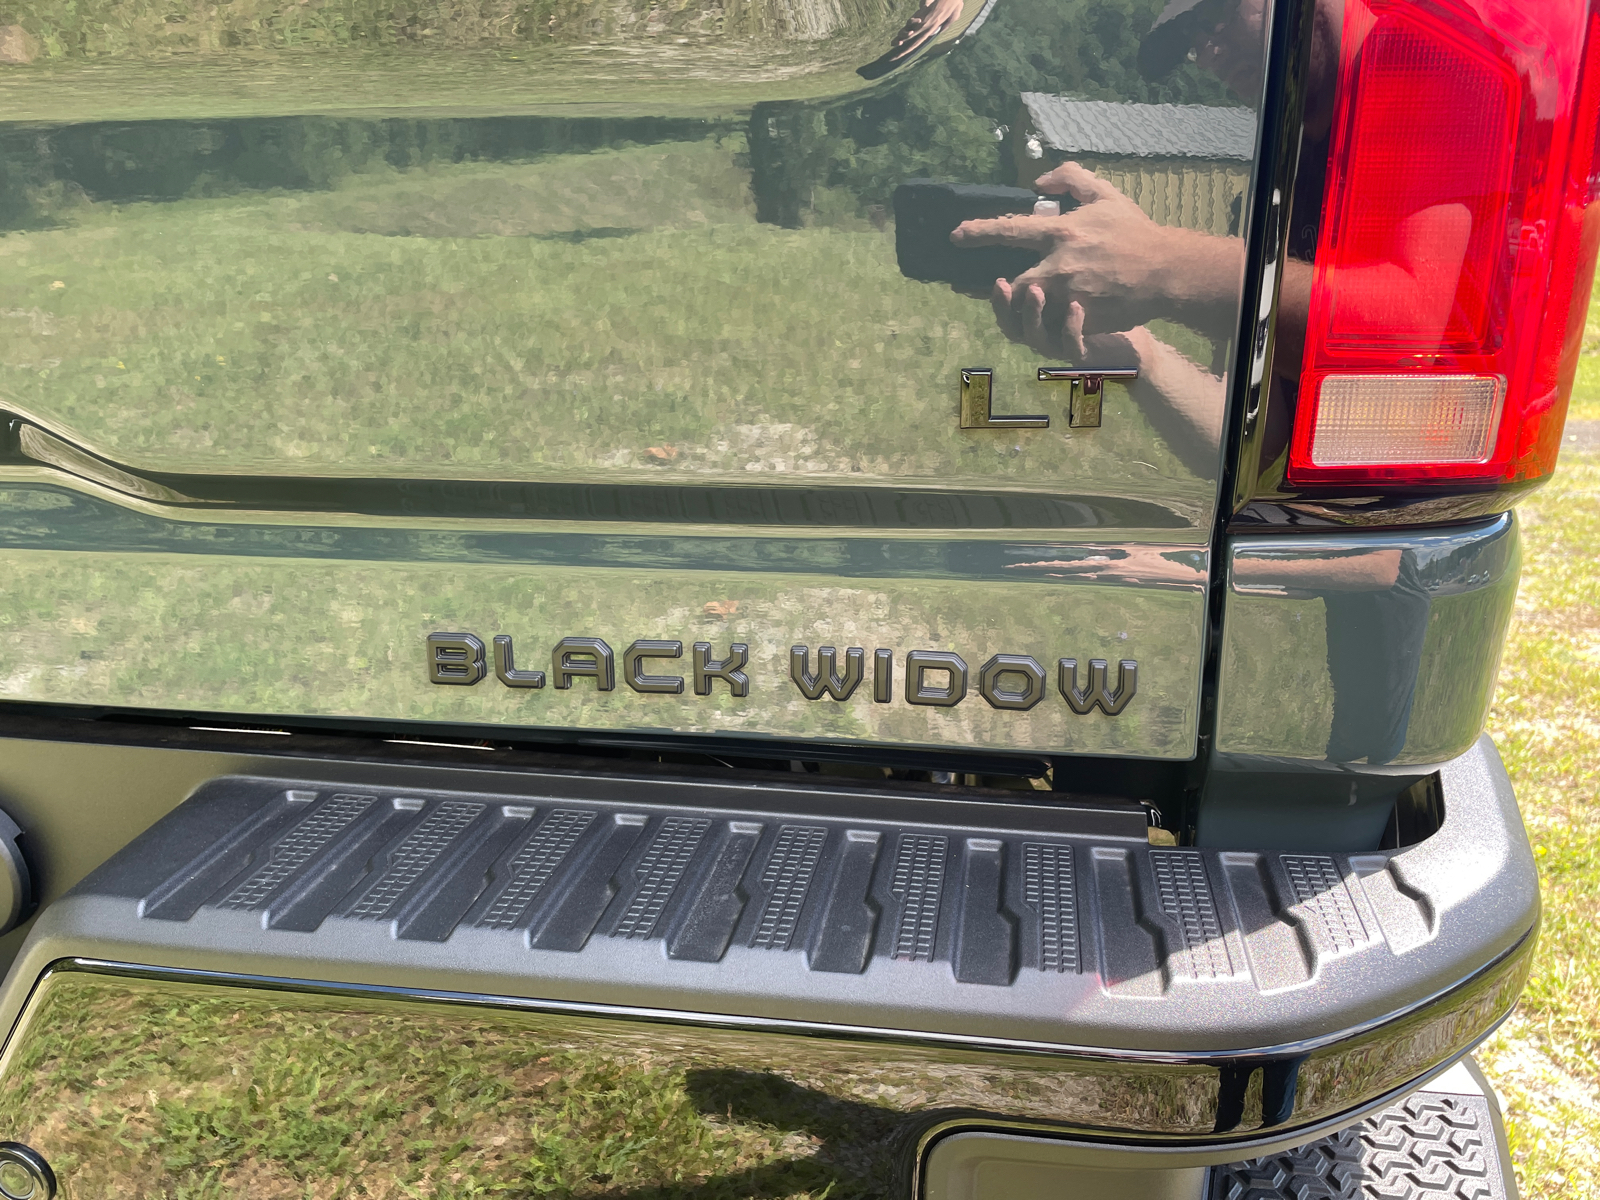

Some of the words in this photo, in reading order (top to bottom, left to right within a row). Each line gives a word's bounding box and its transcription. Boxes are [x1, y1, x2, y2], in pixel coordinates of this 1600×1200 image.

[960, 367, 1138, 429] LT
[427, 632, 749, 698] BLACK
[790, 645, 1138, 716] WIDOW
